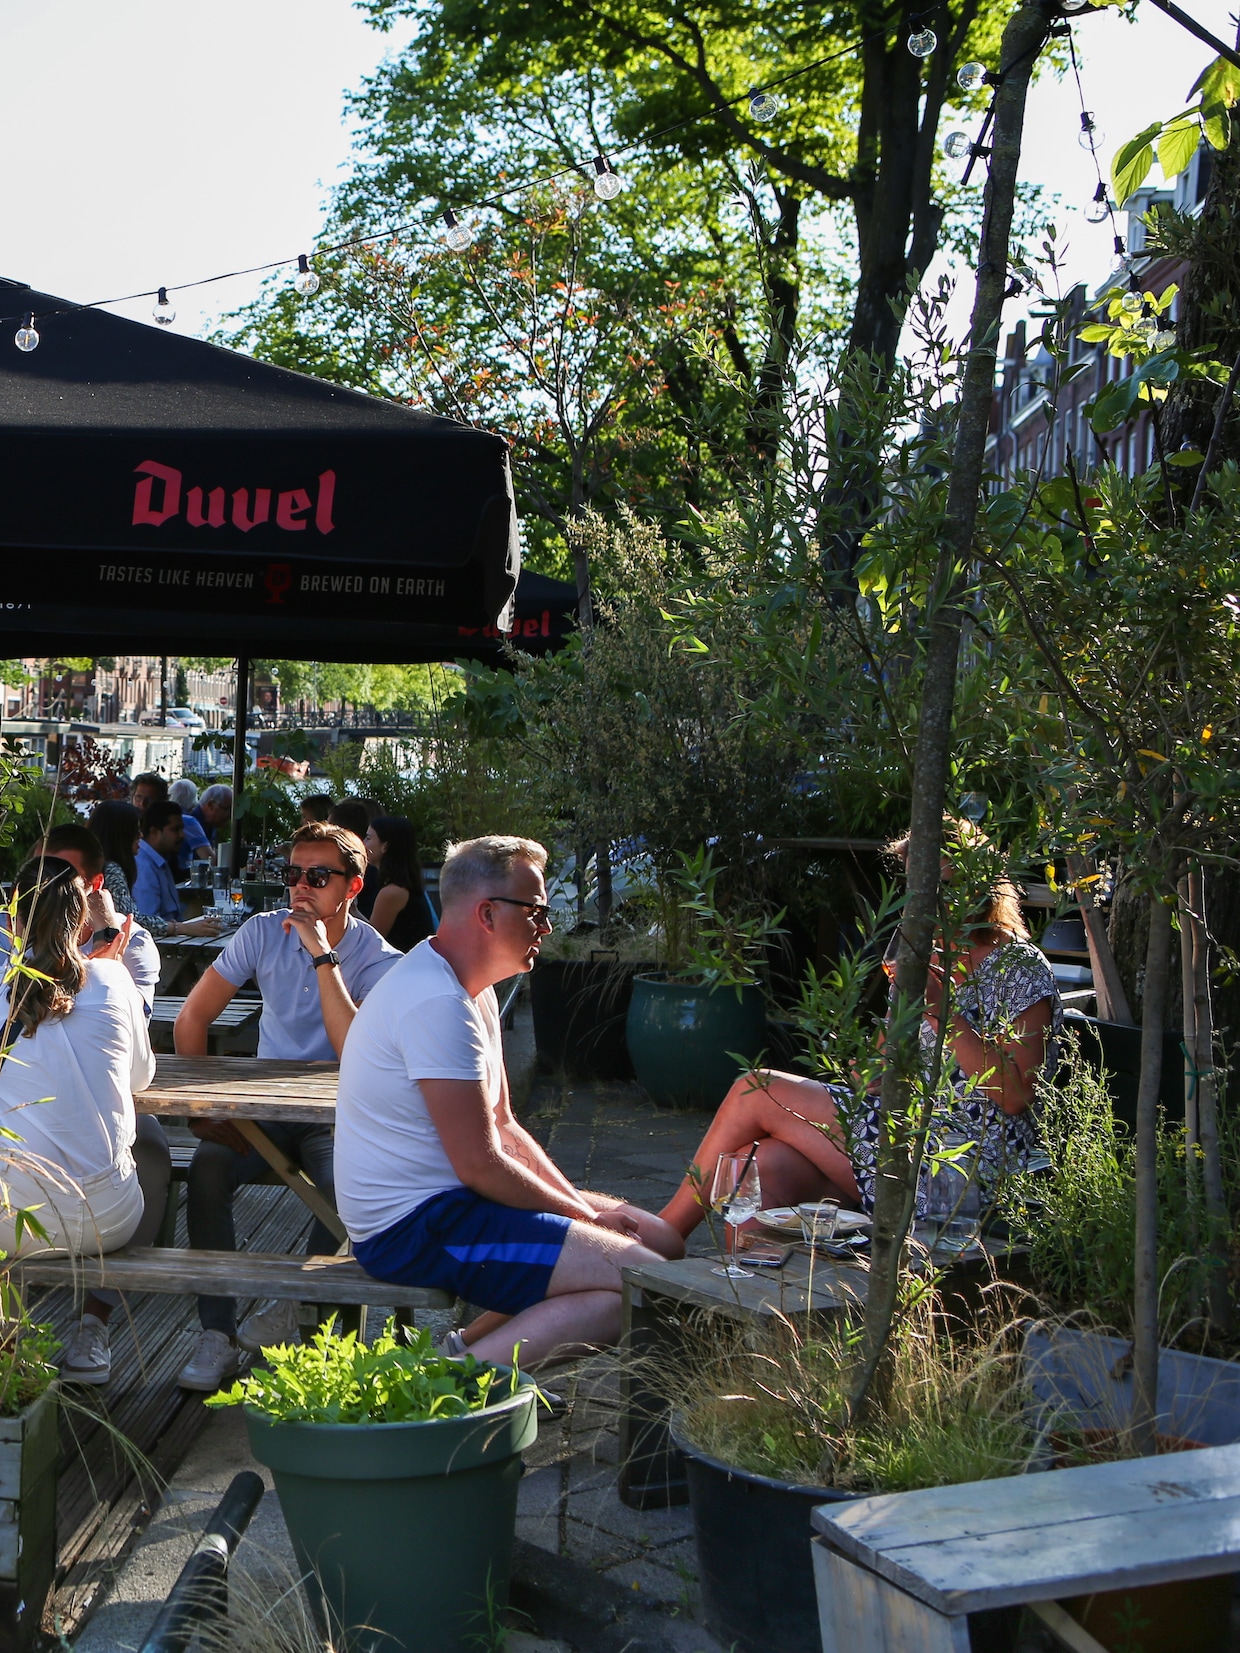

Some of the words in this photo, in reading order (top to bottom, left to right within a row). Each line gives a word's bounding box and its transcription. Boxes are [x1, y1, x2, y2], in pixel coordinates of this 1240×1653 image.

[131, 459, 336, 535] Duvel
[99, 564, 153, 583] TASTES
[158, 569, 191, 586] LIKE
[196, 571, 254, 589] HEAVEN
[300, 575, 363, 593] BREWED
[369, 576, 390, 594] ON
[396, 577, 445, 597] EARTH
